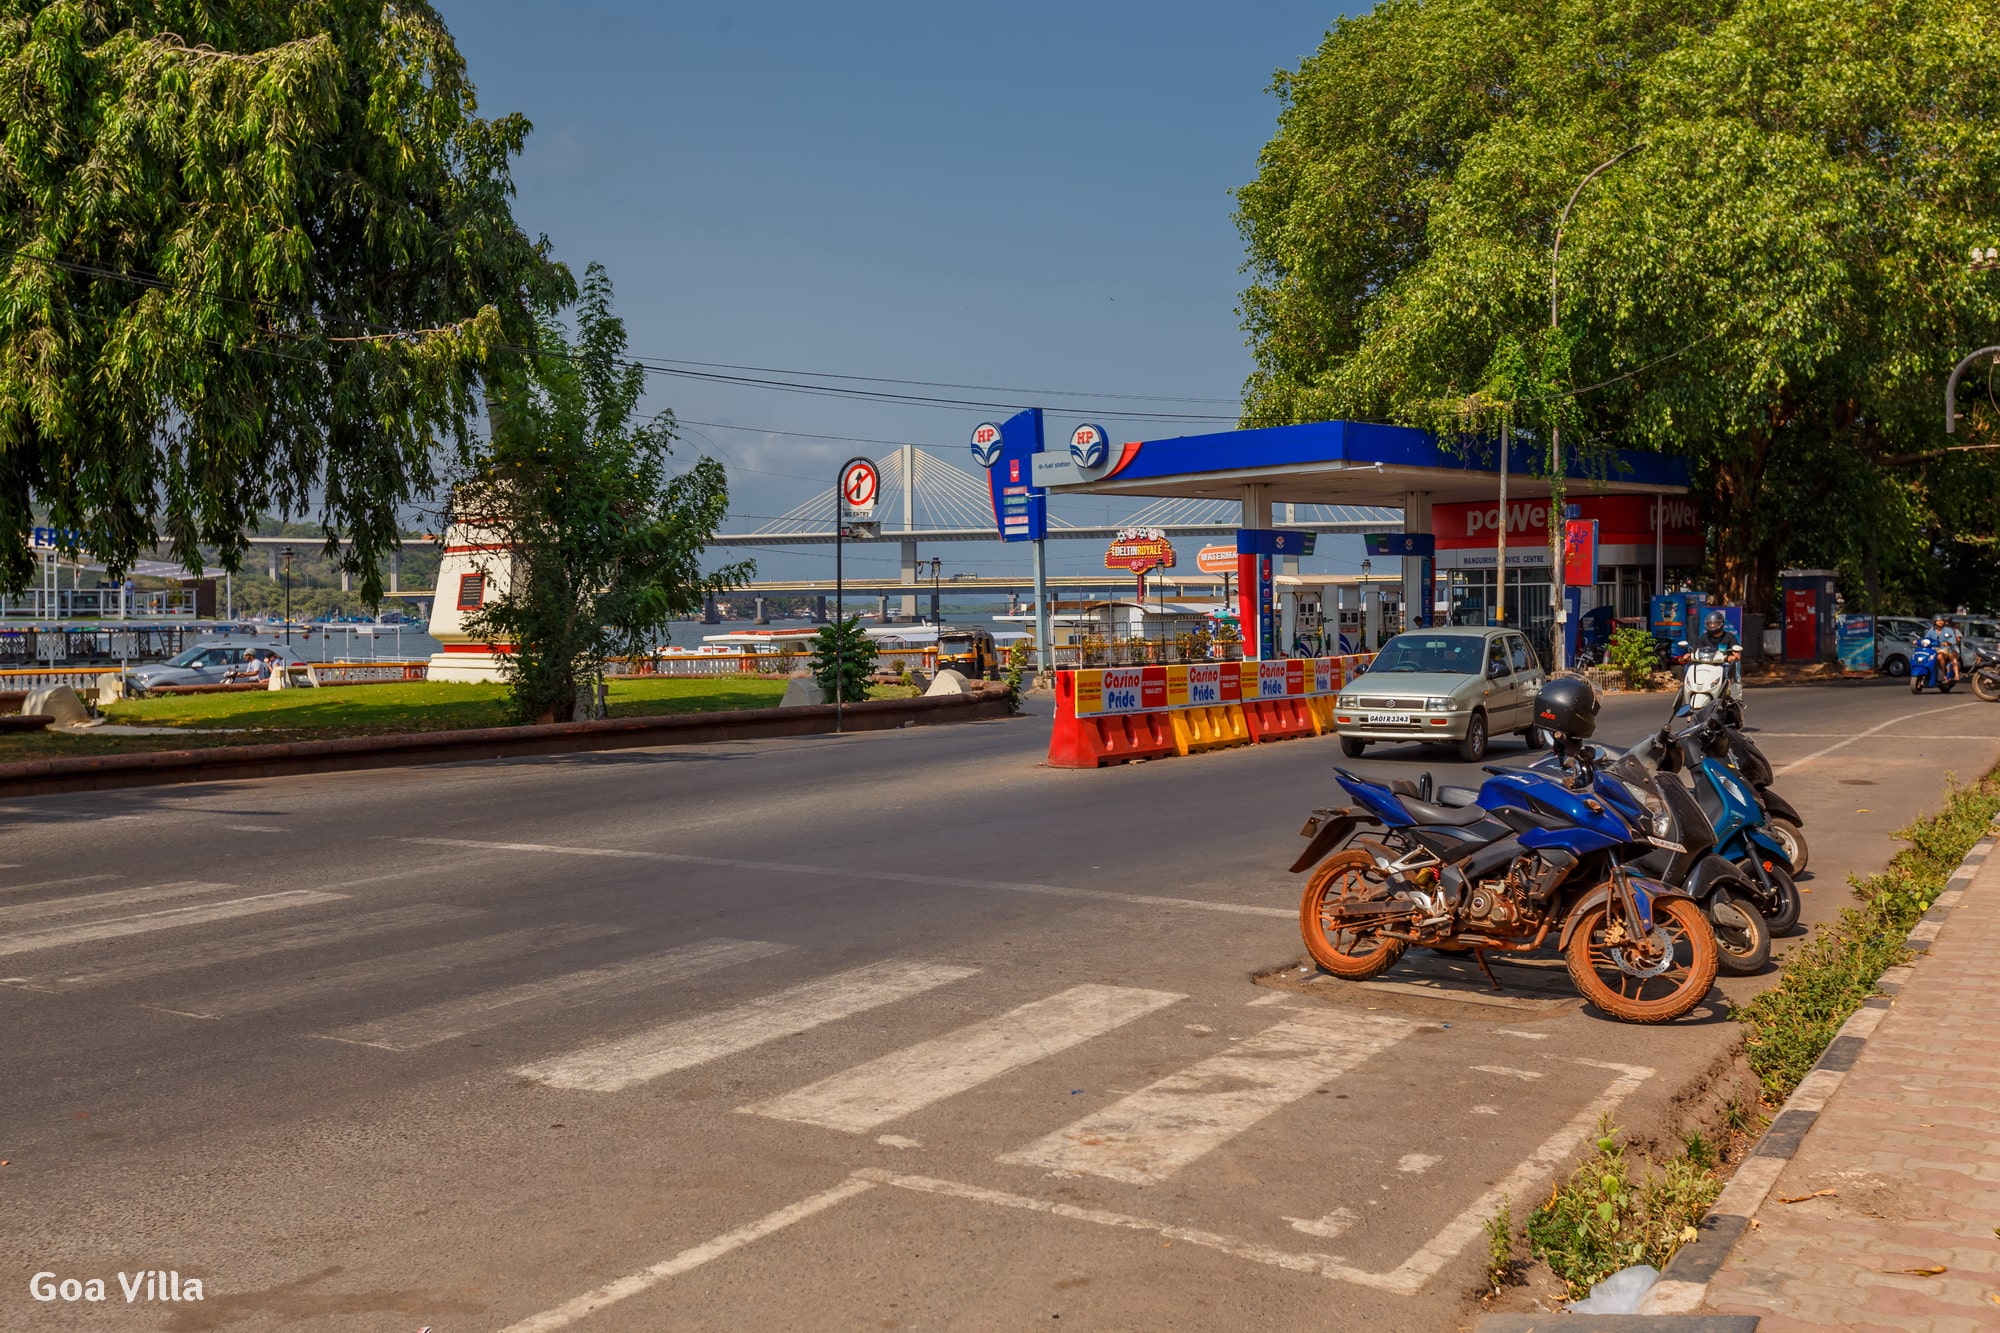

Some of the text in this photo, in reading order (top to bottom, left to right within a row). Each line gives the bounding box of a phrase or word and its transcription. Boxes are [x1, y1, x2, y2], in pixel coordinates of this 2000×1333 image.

[977, 429, 995, 443] HP
[1076, 430, 1094, 445] HP
[1054, 461, 1071, 469] station
[1008, 506, 1026, 514] Diesel
[1466, 503, 1555, 536] poWe
[1200, 550, 1238, 561] WATERMA
[1523, 555, 1545, 563] CENTRE
[1189, 667, 1218, 683] Casino
[1259, 663, 1285, 679] Casino
[1104, 670, 1140, 689] Casino
[1262, 679, 1282, 696] Pride
[1108, 690, 1136, 709] Pride
[1193, 684, 1215, 702] Pride
